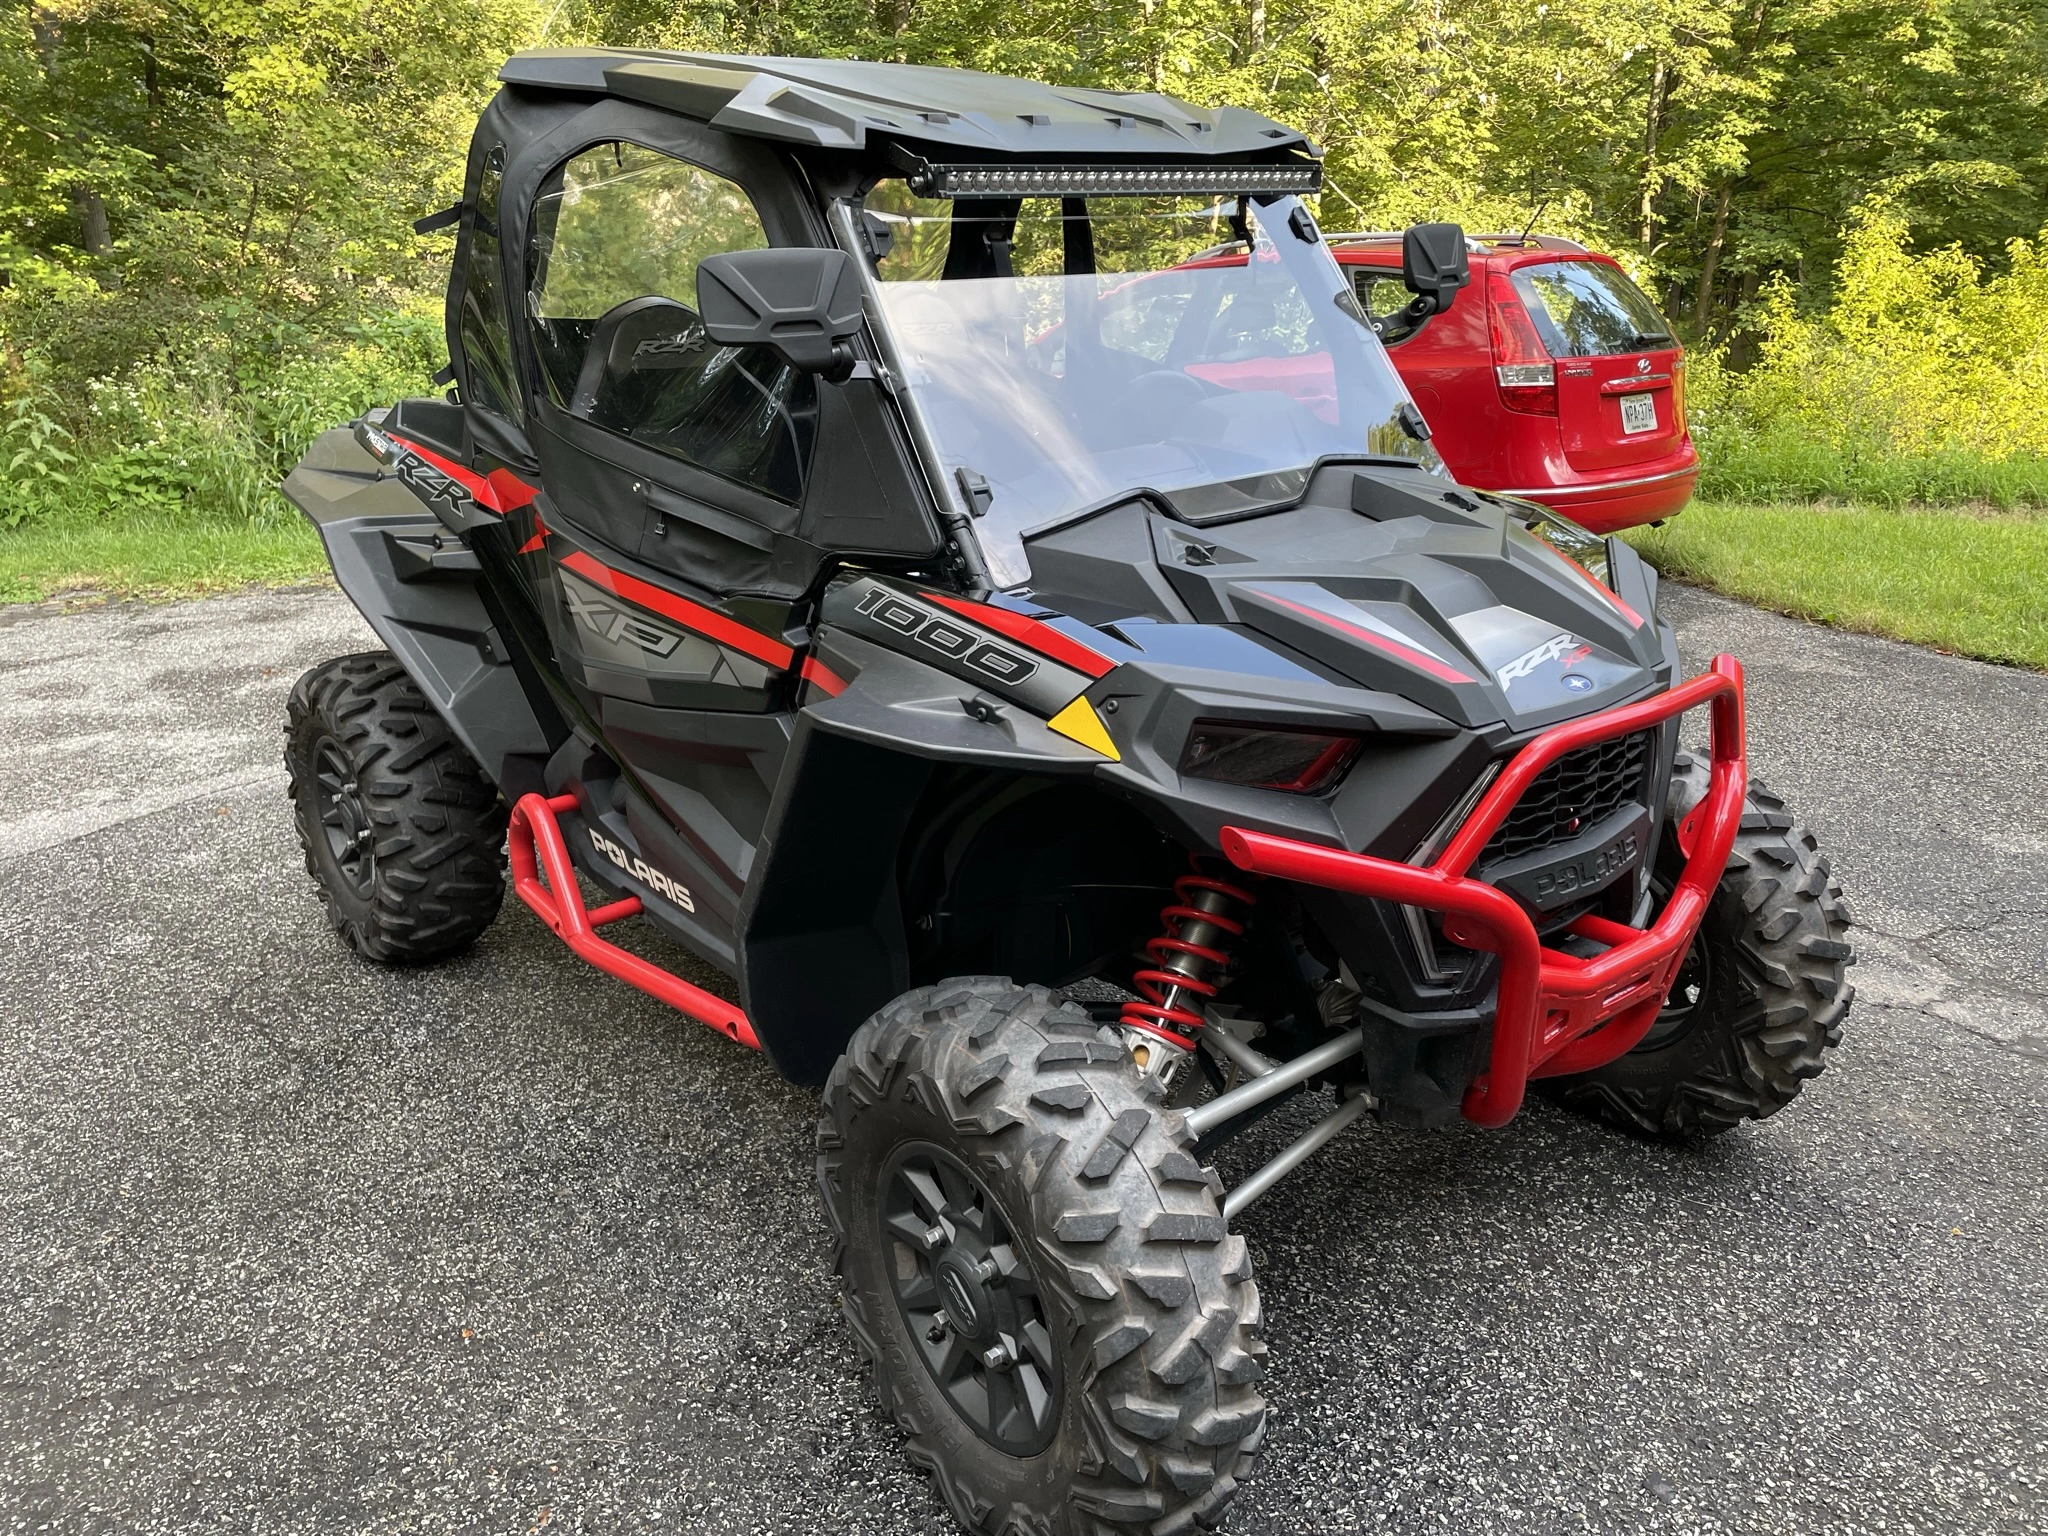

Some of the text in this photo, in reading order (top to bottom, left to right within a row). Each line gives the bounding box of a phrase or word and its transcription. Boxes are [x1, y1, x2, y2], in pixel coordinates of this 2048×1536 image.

[633, 339, 706, 355] RZR
[391, 449, 474, 519] RZR
[563, 582, 686, 660] XP
[854, 586, 1040, 686] 1000
[1496, 632, 1581, 693] RZR
[1559, 645, 1592, 670] XP
[588, 827, 695, 914] POLARIS
[1533, 831, 1638, 903] POLARIS
